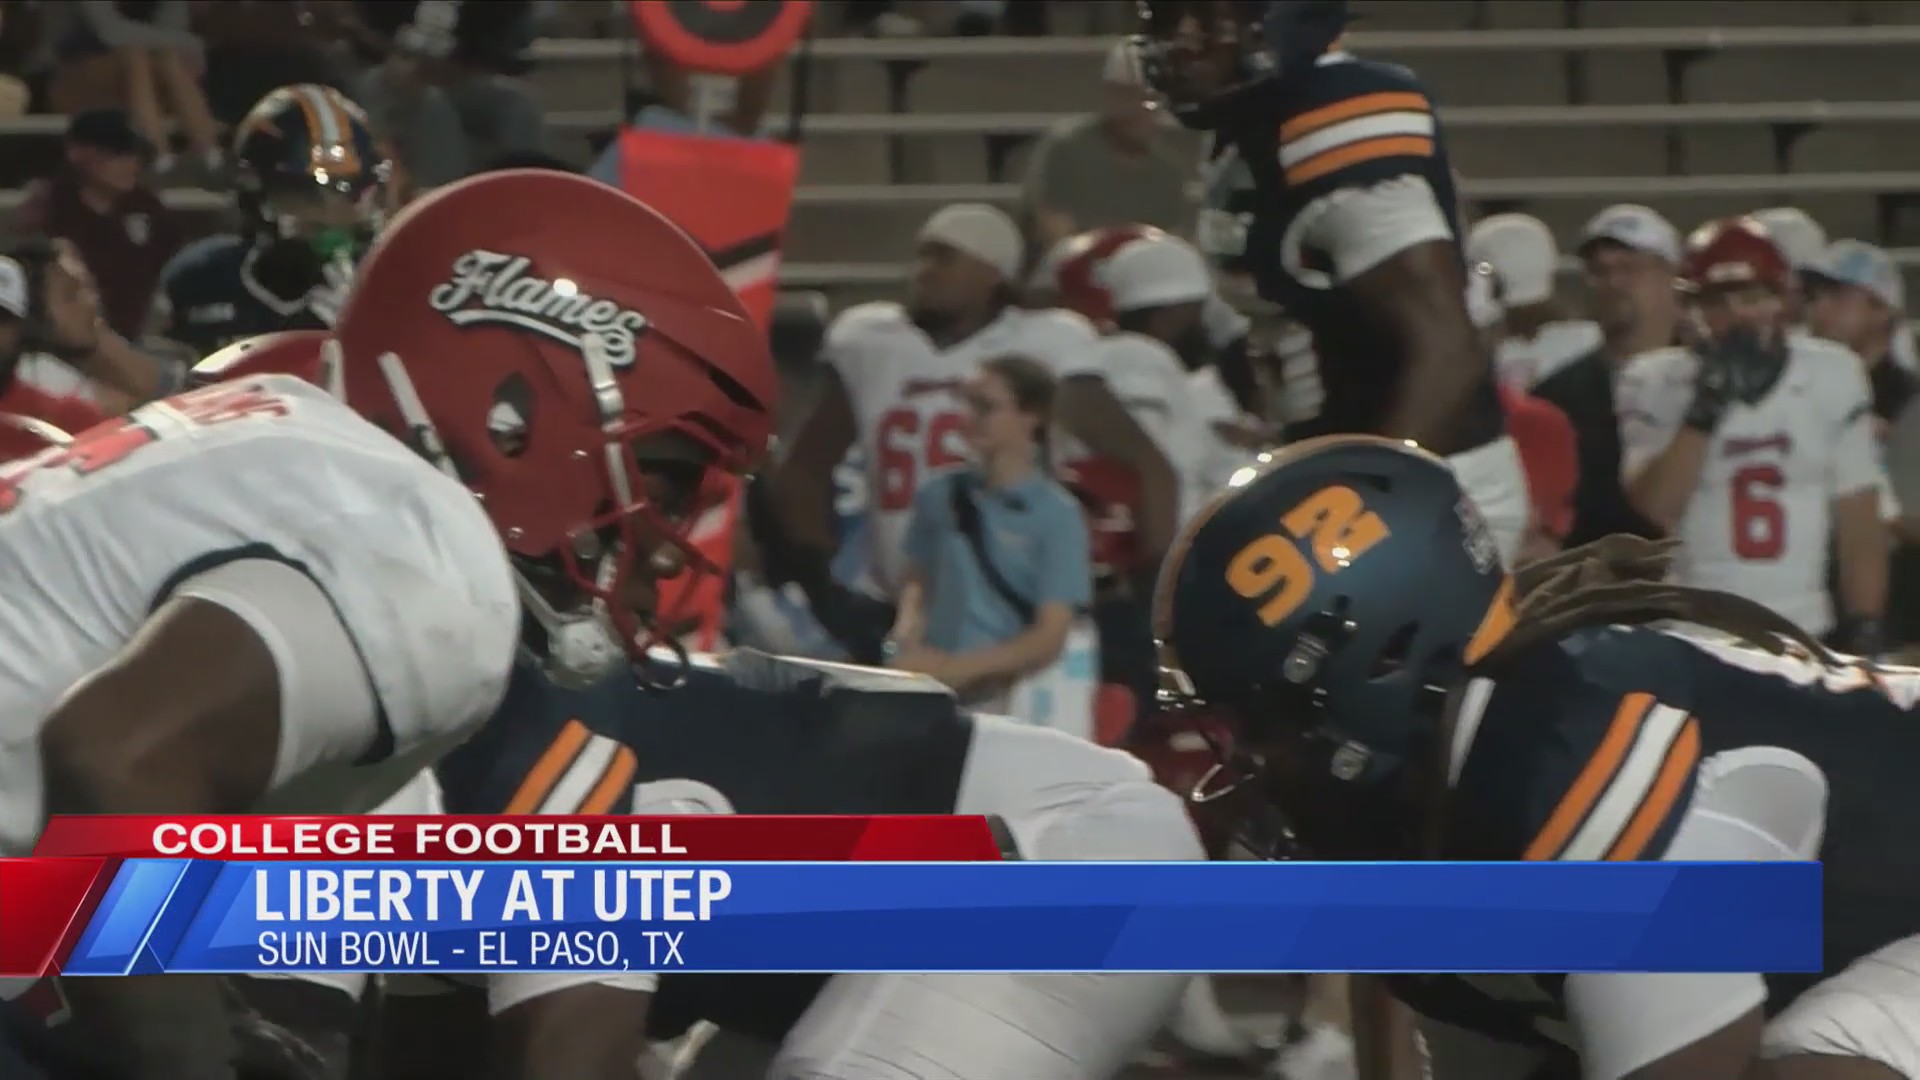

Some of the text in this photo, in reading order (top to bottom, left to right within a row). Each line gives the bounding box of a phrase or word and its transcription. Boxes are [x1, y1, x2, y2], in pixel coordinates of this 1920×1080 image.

[428, 248, 647, 367] Flames
[1224, 485, 1392, 628] 92
[1732, 464, 1787, 562] 6
